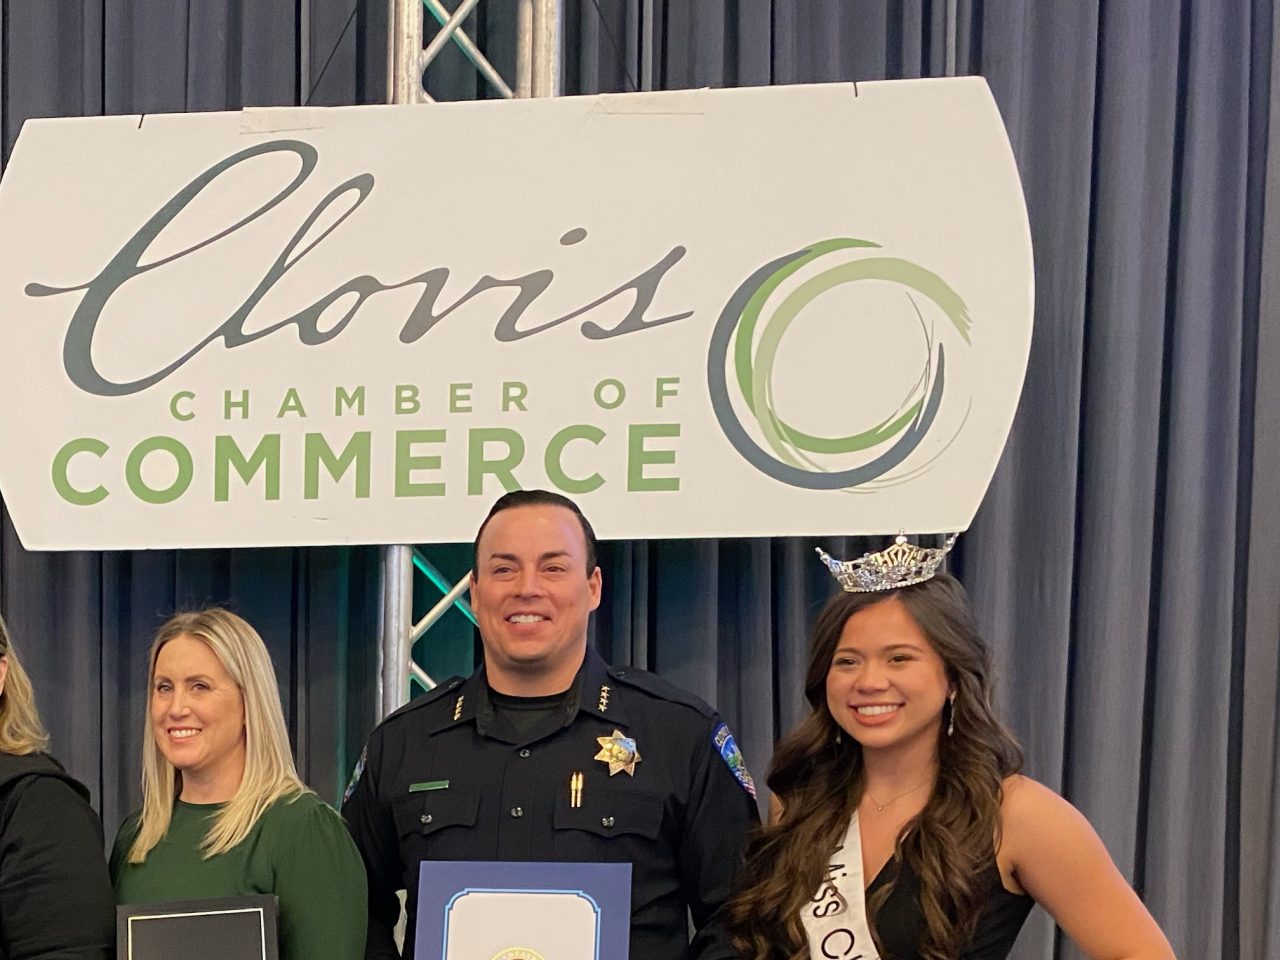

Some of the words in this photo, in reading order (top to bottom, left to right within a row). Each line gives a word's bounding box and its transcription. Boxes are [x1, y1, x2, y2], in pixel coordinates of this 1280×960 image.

[24, 138, 695, 397] Clovis
[169, 380, 529, 422] CHAMBER
[593, 376, 681, 410] OF
[51, 422, 682, 507] COMMERCE
